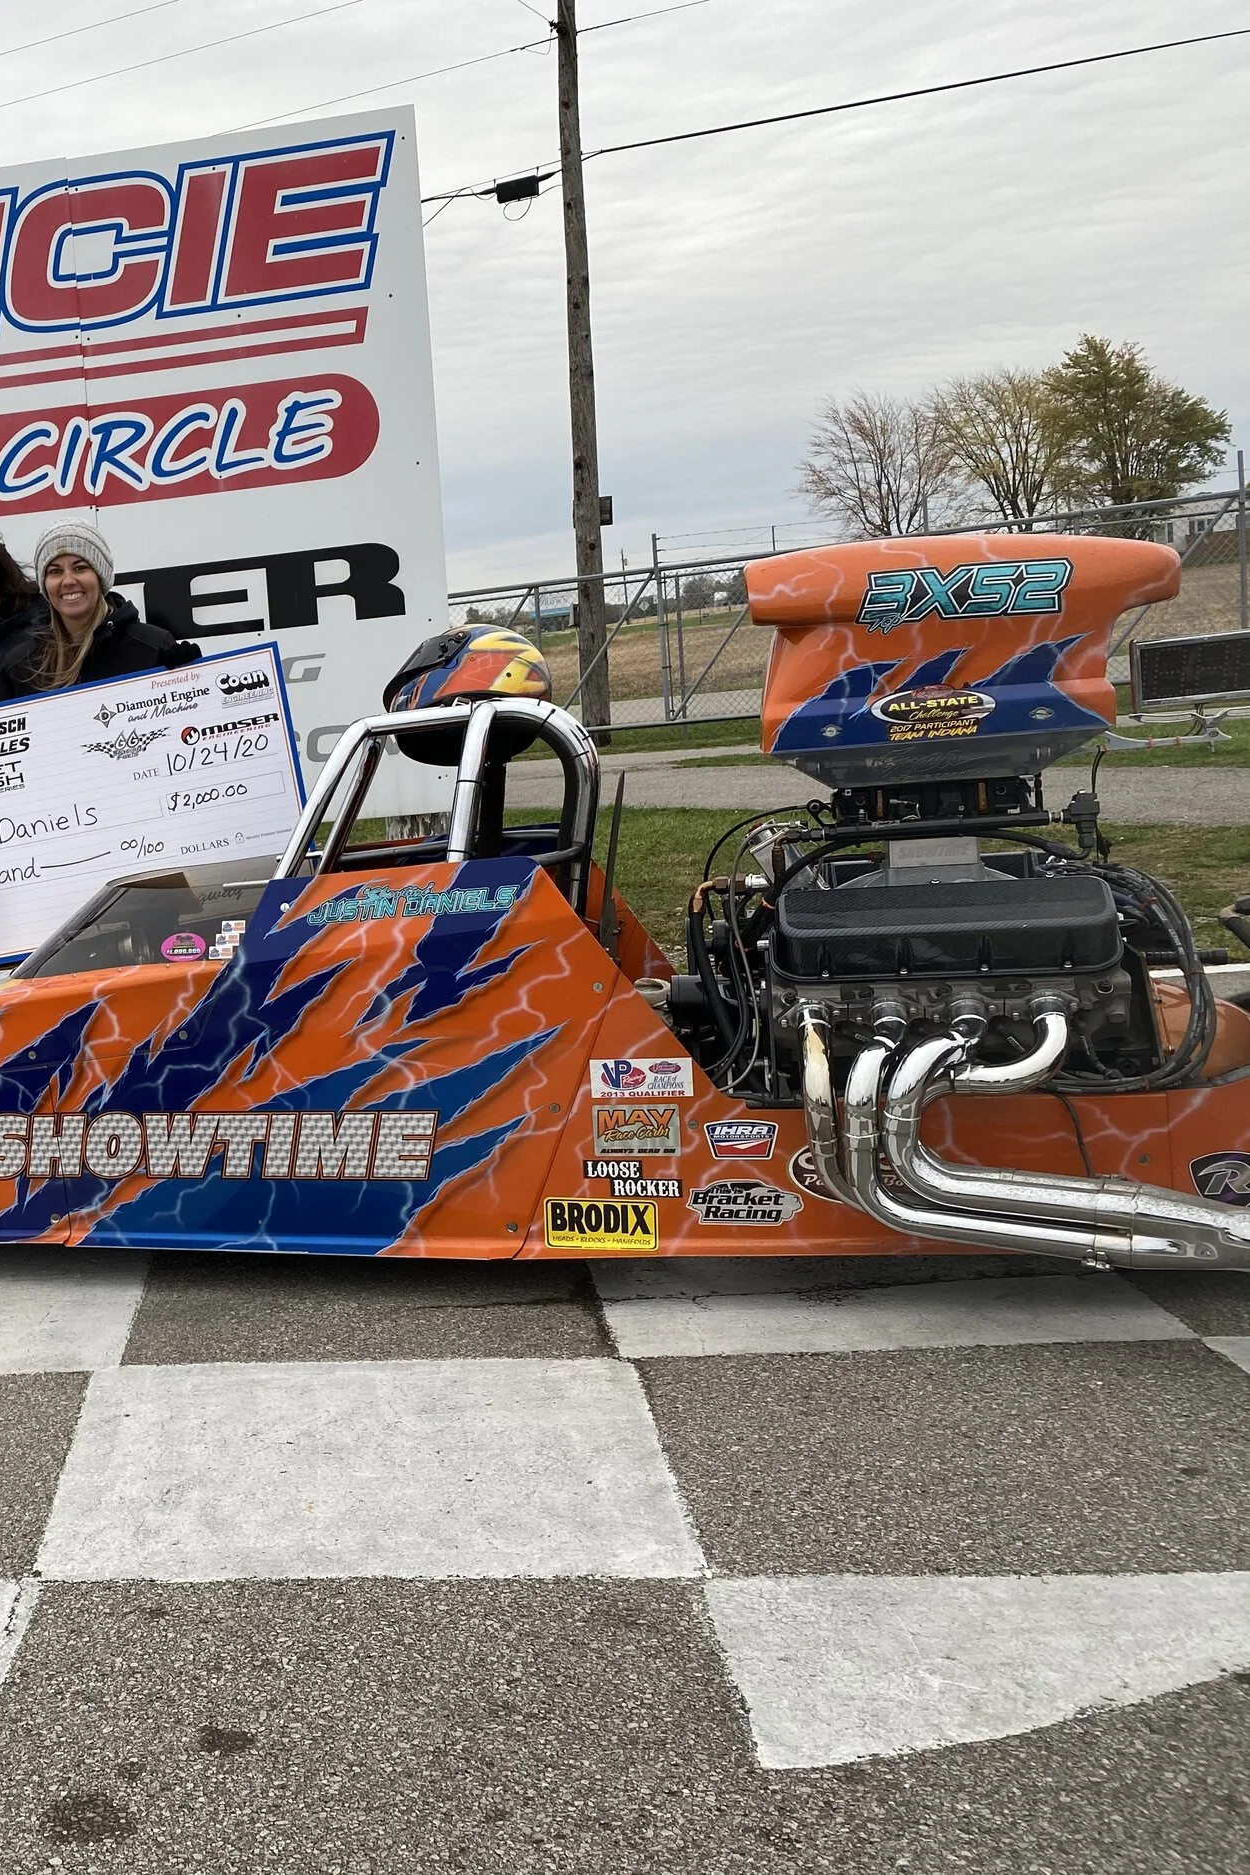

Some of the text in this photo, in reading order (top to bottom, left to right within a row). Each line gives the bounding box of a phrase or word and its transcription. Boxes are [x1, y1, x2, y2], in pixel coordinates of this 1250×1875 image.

[856, 557, 1073, 624] 3X52
[151, 672, 200, 690] Presented by
[215, 669, 270, 695] Coan
[116, 687, 210, 713] Diamond Engine
[128, 702, 198, 723] and Machine
[203, 724, 271, 741] ENGINEERING
[890, 718, 976, 733] 2017 PARTICIPANT
[890, 725, 978, 741] TEAM INDIANA
[167, 733, 269, 776] 10/24/20
[133, 768, 160, 781] DATE
[168, 783, 248, 811] $2,000.00
[180, 838, 230, 856] DOLLARS
[307, 897, 397, 926] JUSTIN
[402, 884, 520, 917] DANIELS
[601, 1060, 631, 1088] VP
[647, 1081, 685, 1090] CHAMPIONS
[597, 1109, 676, 1139] MAY
[603, 1123, 670, 1143] Race Carbs
[714, 1125, 769, 1135] IHRA
[586, 1161, 640, 1178] LOOSE
[613, 1179, 680, 1197] ROCKER
[692, 1191, 785, 1206] Bracket
[550, 1202, 652, 1236] BRODIX
[704, 1205, 783, 1222] Racing
[580, 1236, 606, 1244] BLOCKS
[612, 1237, 651, 1245] MANIFOLDS
